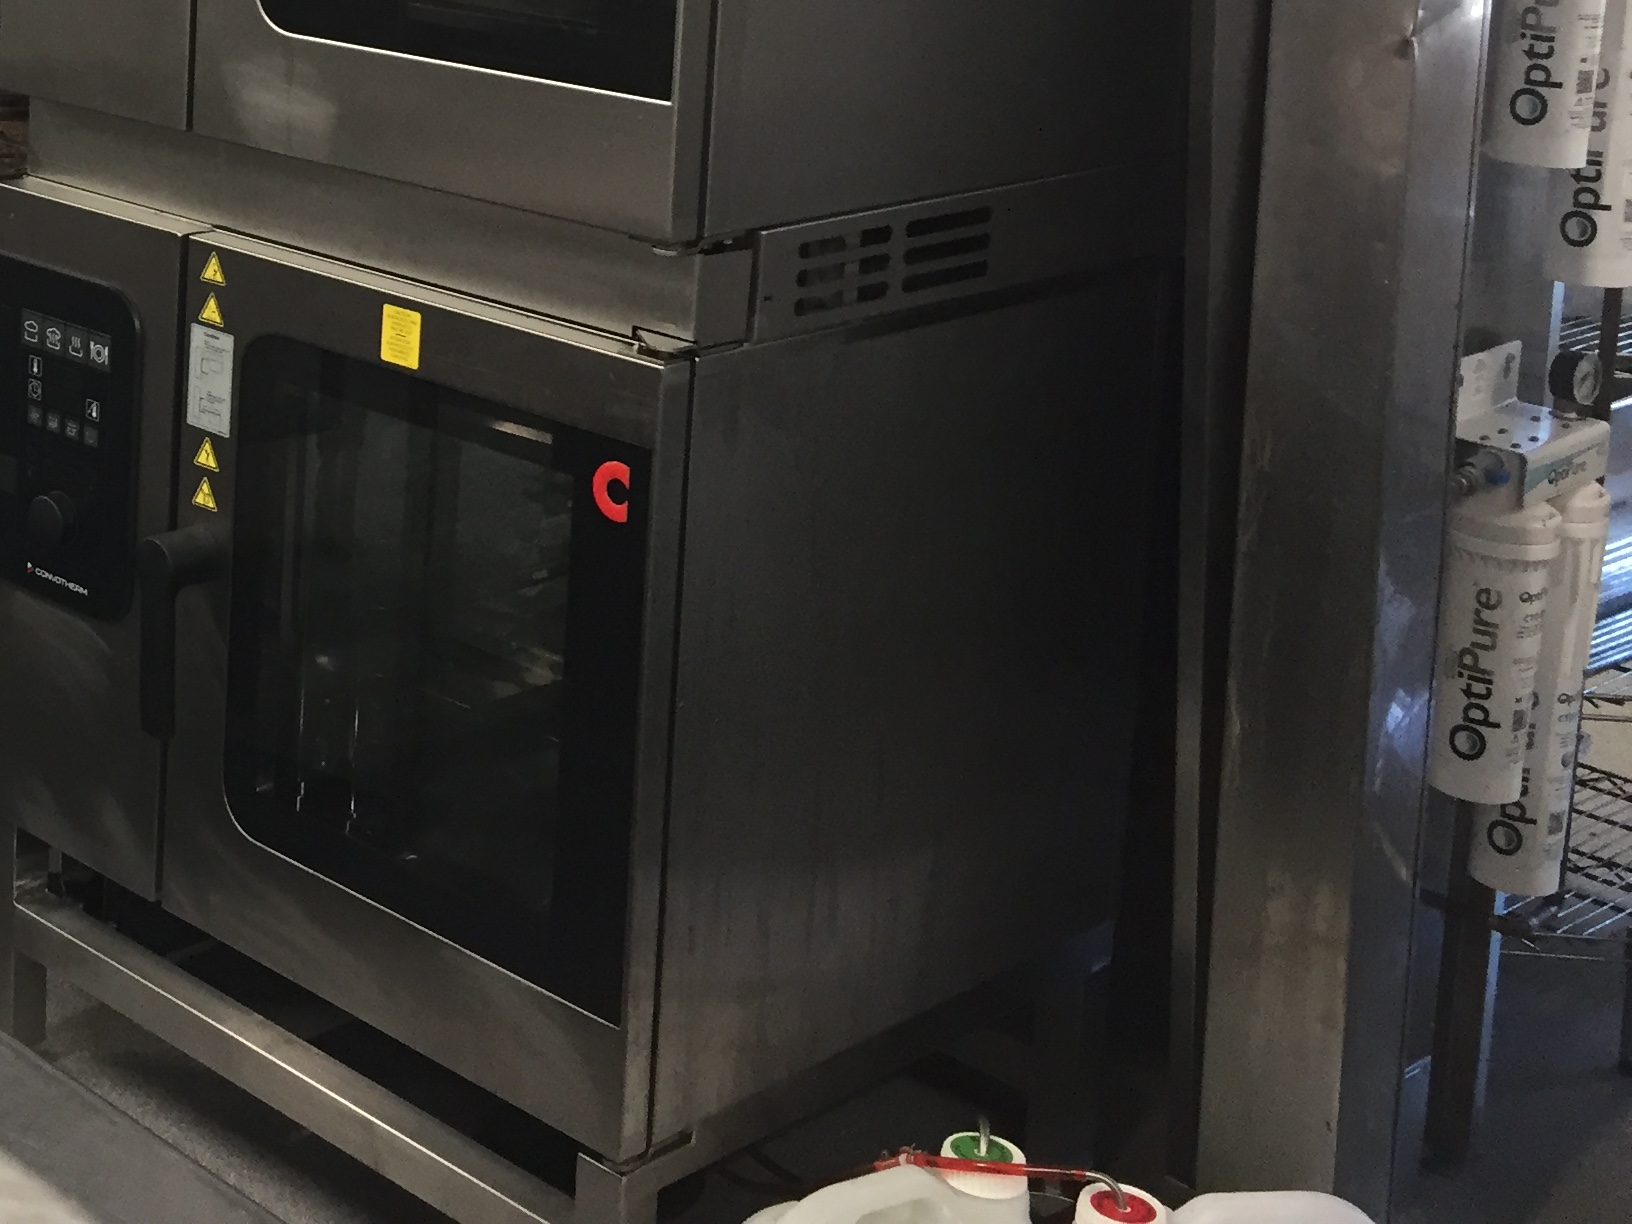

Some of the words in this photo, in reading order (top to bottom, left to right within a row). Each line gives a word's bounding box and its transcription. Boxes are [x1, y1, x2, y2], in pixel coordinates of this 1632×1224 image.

[1560, 68, 1613, 247] Optiu
[35, 567, 88, 596] CONVOTHERM
[1449, 587, 1502, 761] OptiPure
